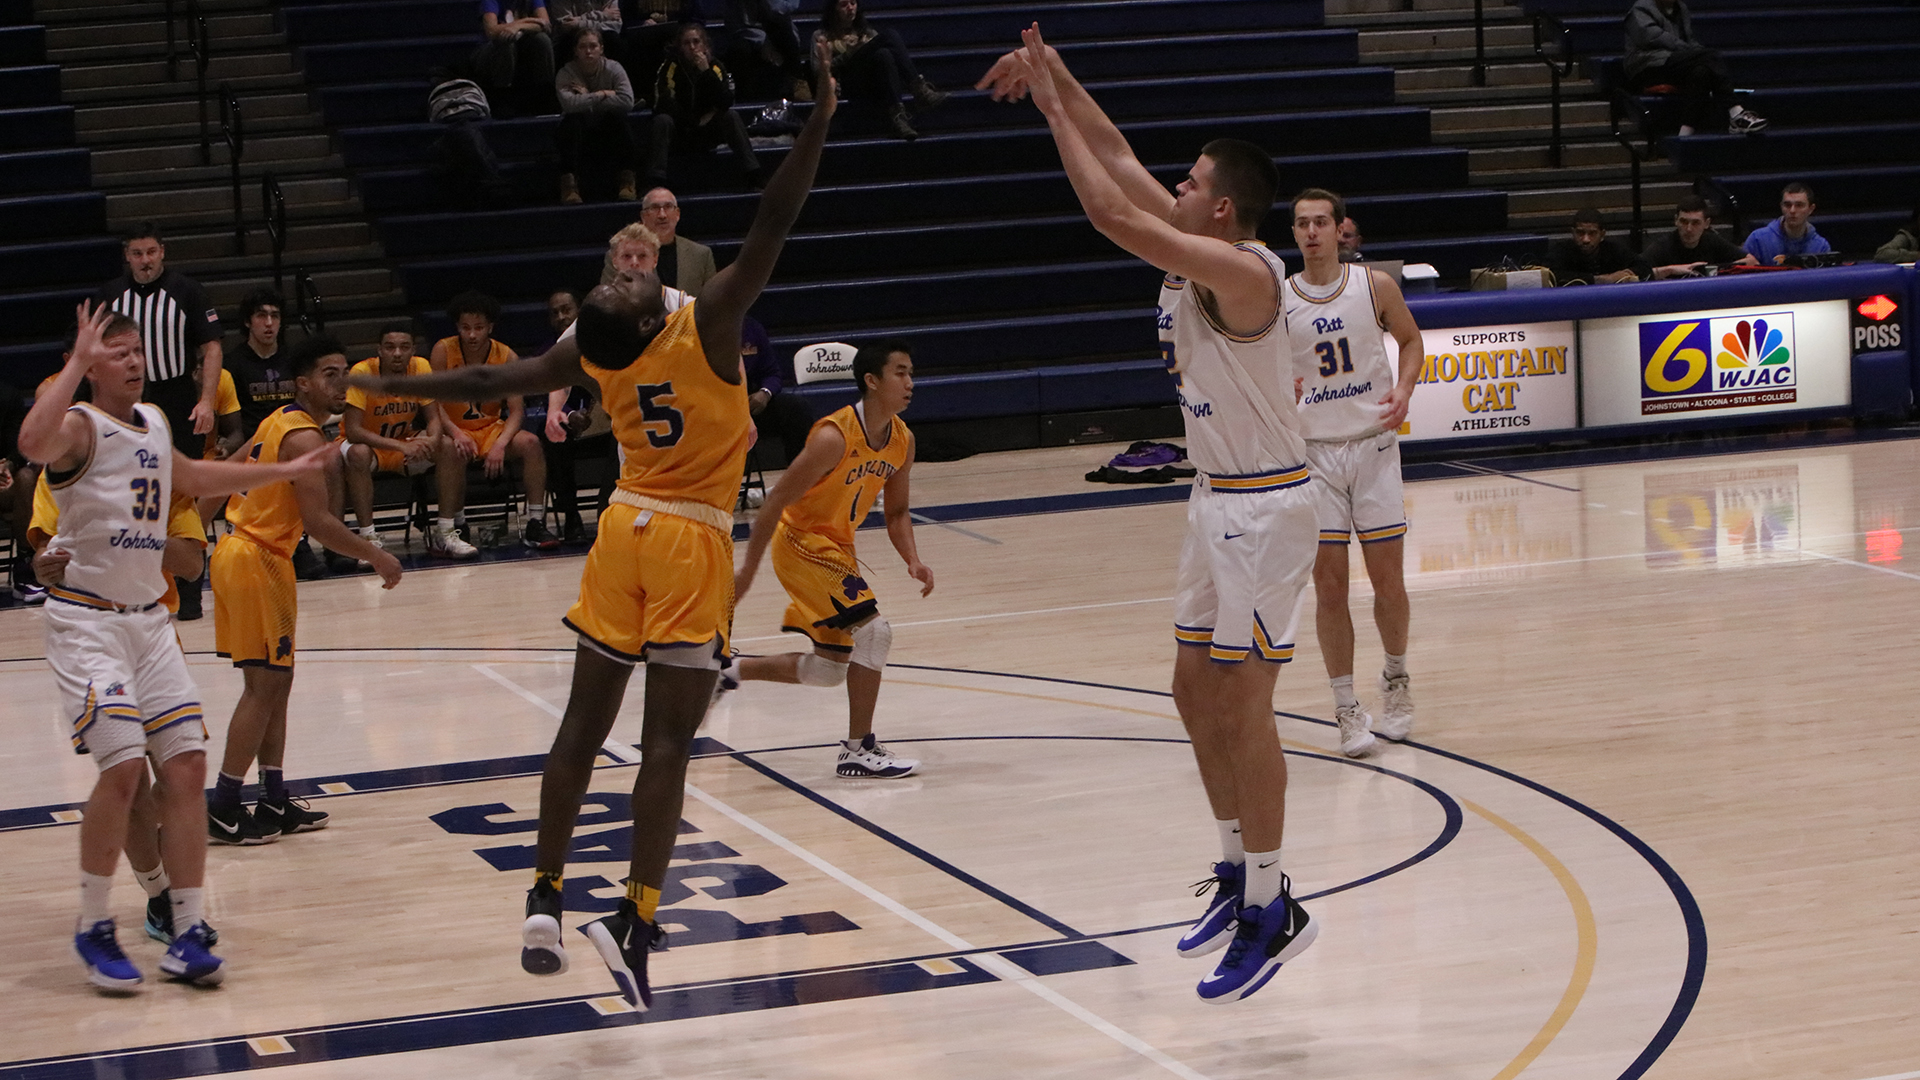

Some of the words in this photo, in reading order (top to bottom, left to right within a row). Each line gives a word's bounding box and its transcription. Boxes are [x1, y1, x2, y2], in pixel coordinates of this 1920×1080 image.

[1312, 317, 1344, 335] Pitt
[1453, 331, 1526, 346] SUPPORTS
[1854, 323, 1901, 349] POSS
[813, 348, 842, 362] Pitt
[1314, 336, 1355, 379] 31
[1415, 346, 1568, 385] MOUNTAIN
[1644, 322, 1708, 393] 6
[806, 362, 854, 374] Johnstown
[1719, 366, 1791, 389] WJAC
[1305, 380, 1373, 405] Johnstown
[1462, 382, 1521, 414] CAT
[1644, 401, 1690, 412] JOHNSTOWN
[1694, 398, 1729, 408] ALTOONA
[1733, 395, 1757, 404] STATE
[1761, 392, 1795, 402] COLLEGE
[373, 401, 418, 417] CARLOW
[636, 380, 684, 449] 5
[1452, 415, 1531, 432] ATHLETICS
[130, 478, 160, 521] 33
[849, 485, 863, 522] 1
